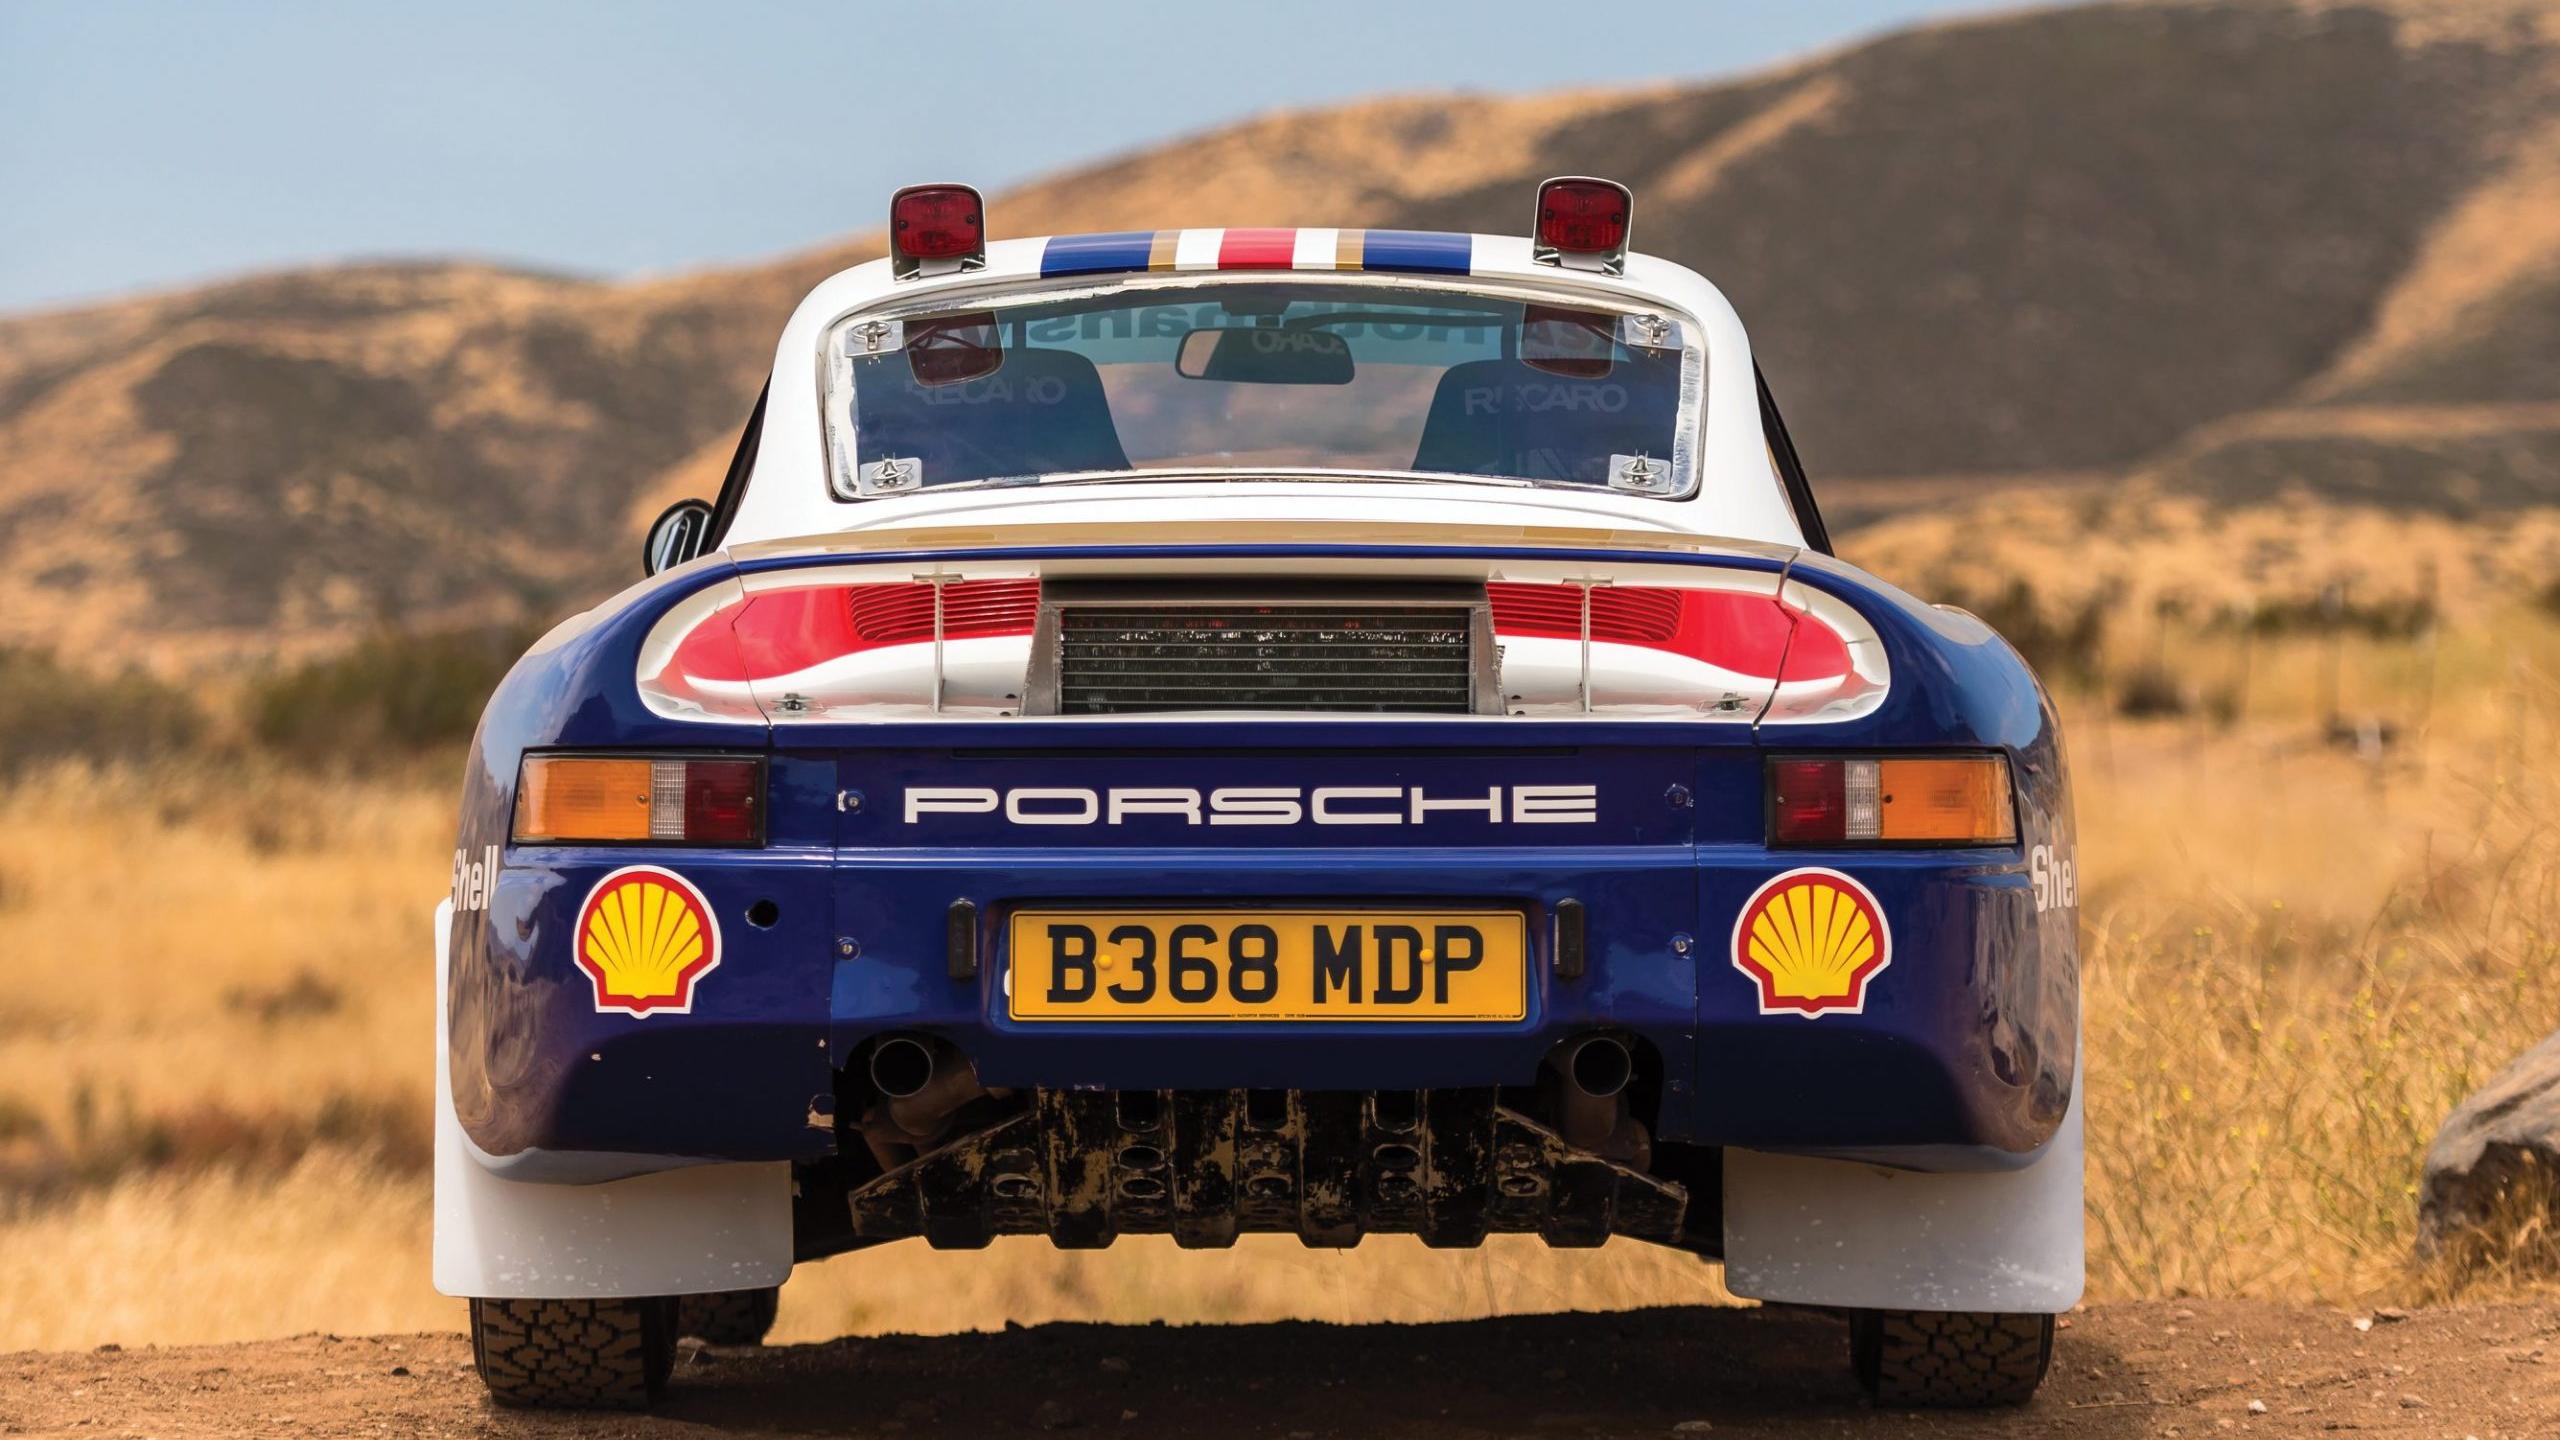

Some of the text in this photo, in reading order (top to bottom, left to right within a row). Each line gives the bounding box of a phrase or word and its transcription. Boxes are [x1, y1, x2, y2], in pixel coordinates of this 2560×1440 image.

[1464, 383, 1630, 416] RCARO
[904, 785, 1598, 825] PORSCHE
[452, 845, 499, 911] Shell
[1046, 924, 1485, 1005] B368 MDP
